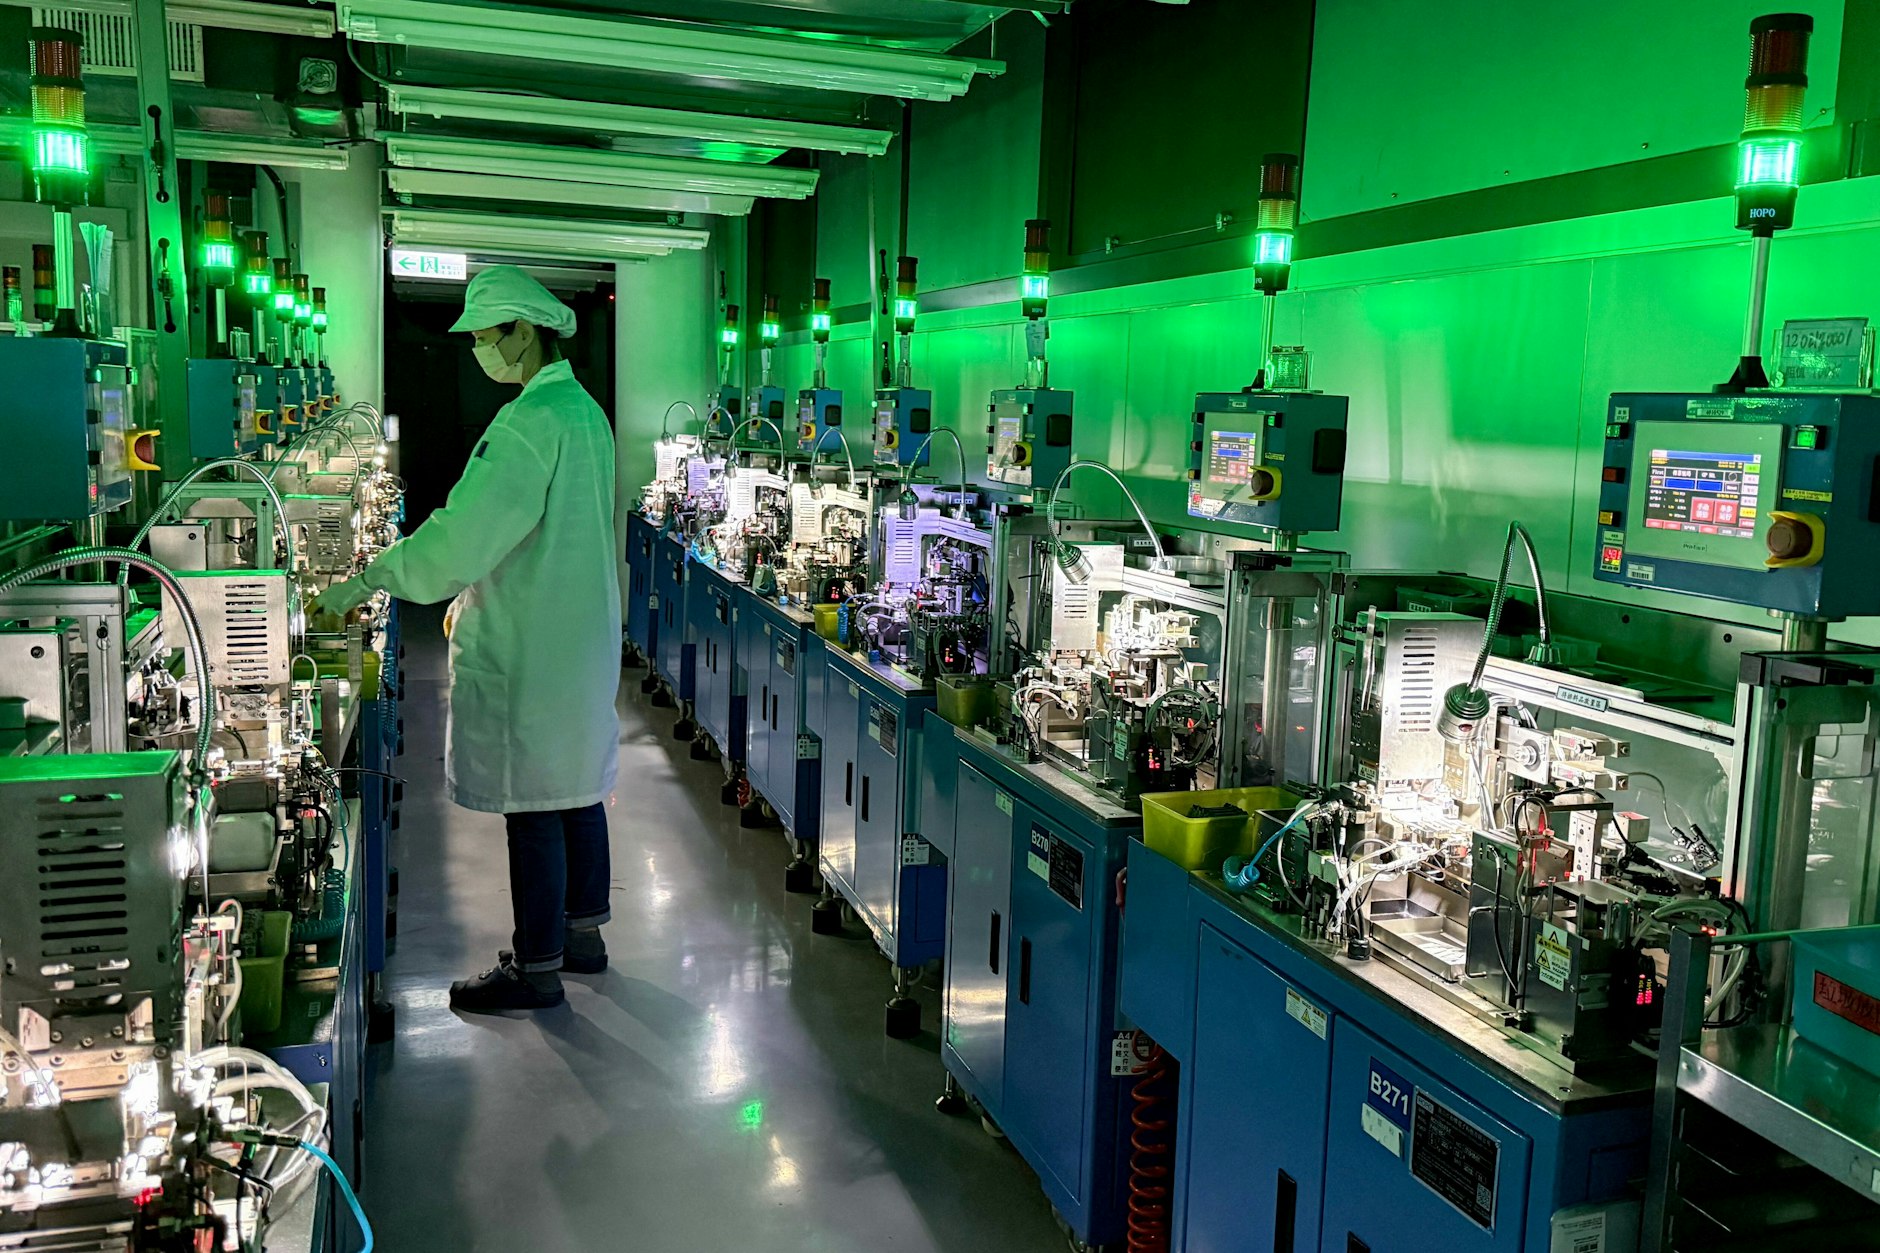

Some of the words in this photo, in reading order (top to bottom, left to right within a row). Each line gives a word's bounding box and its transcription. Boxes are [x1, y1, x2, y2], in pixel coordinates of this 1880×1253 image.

[1749, 208, 1776, 218] HOPO
[1031, 829, 1049, 852] B270
[1117, 1032, 1130, 1040] A4
[1370, 1070, 1409, 1116] B271
